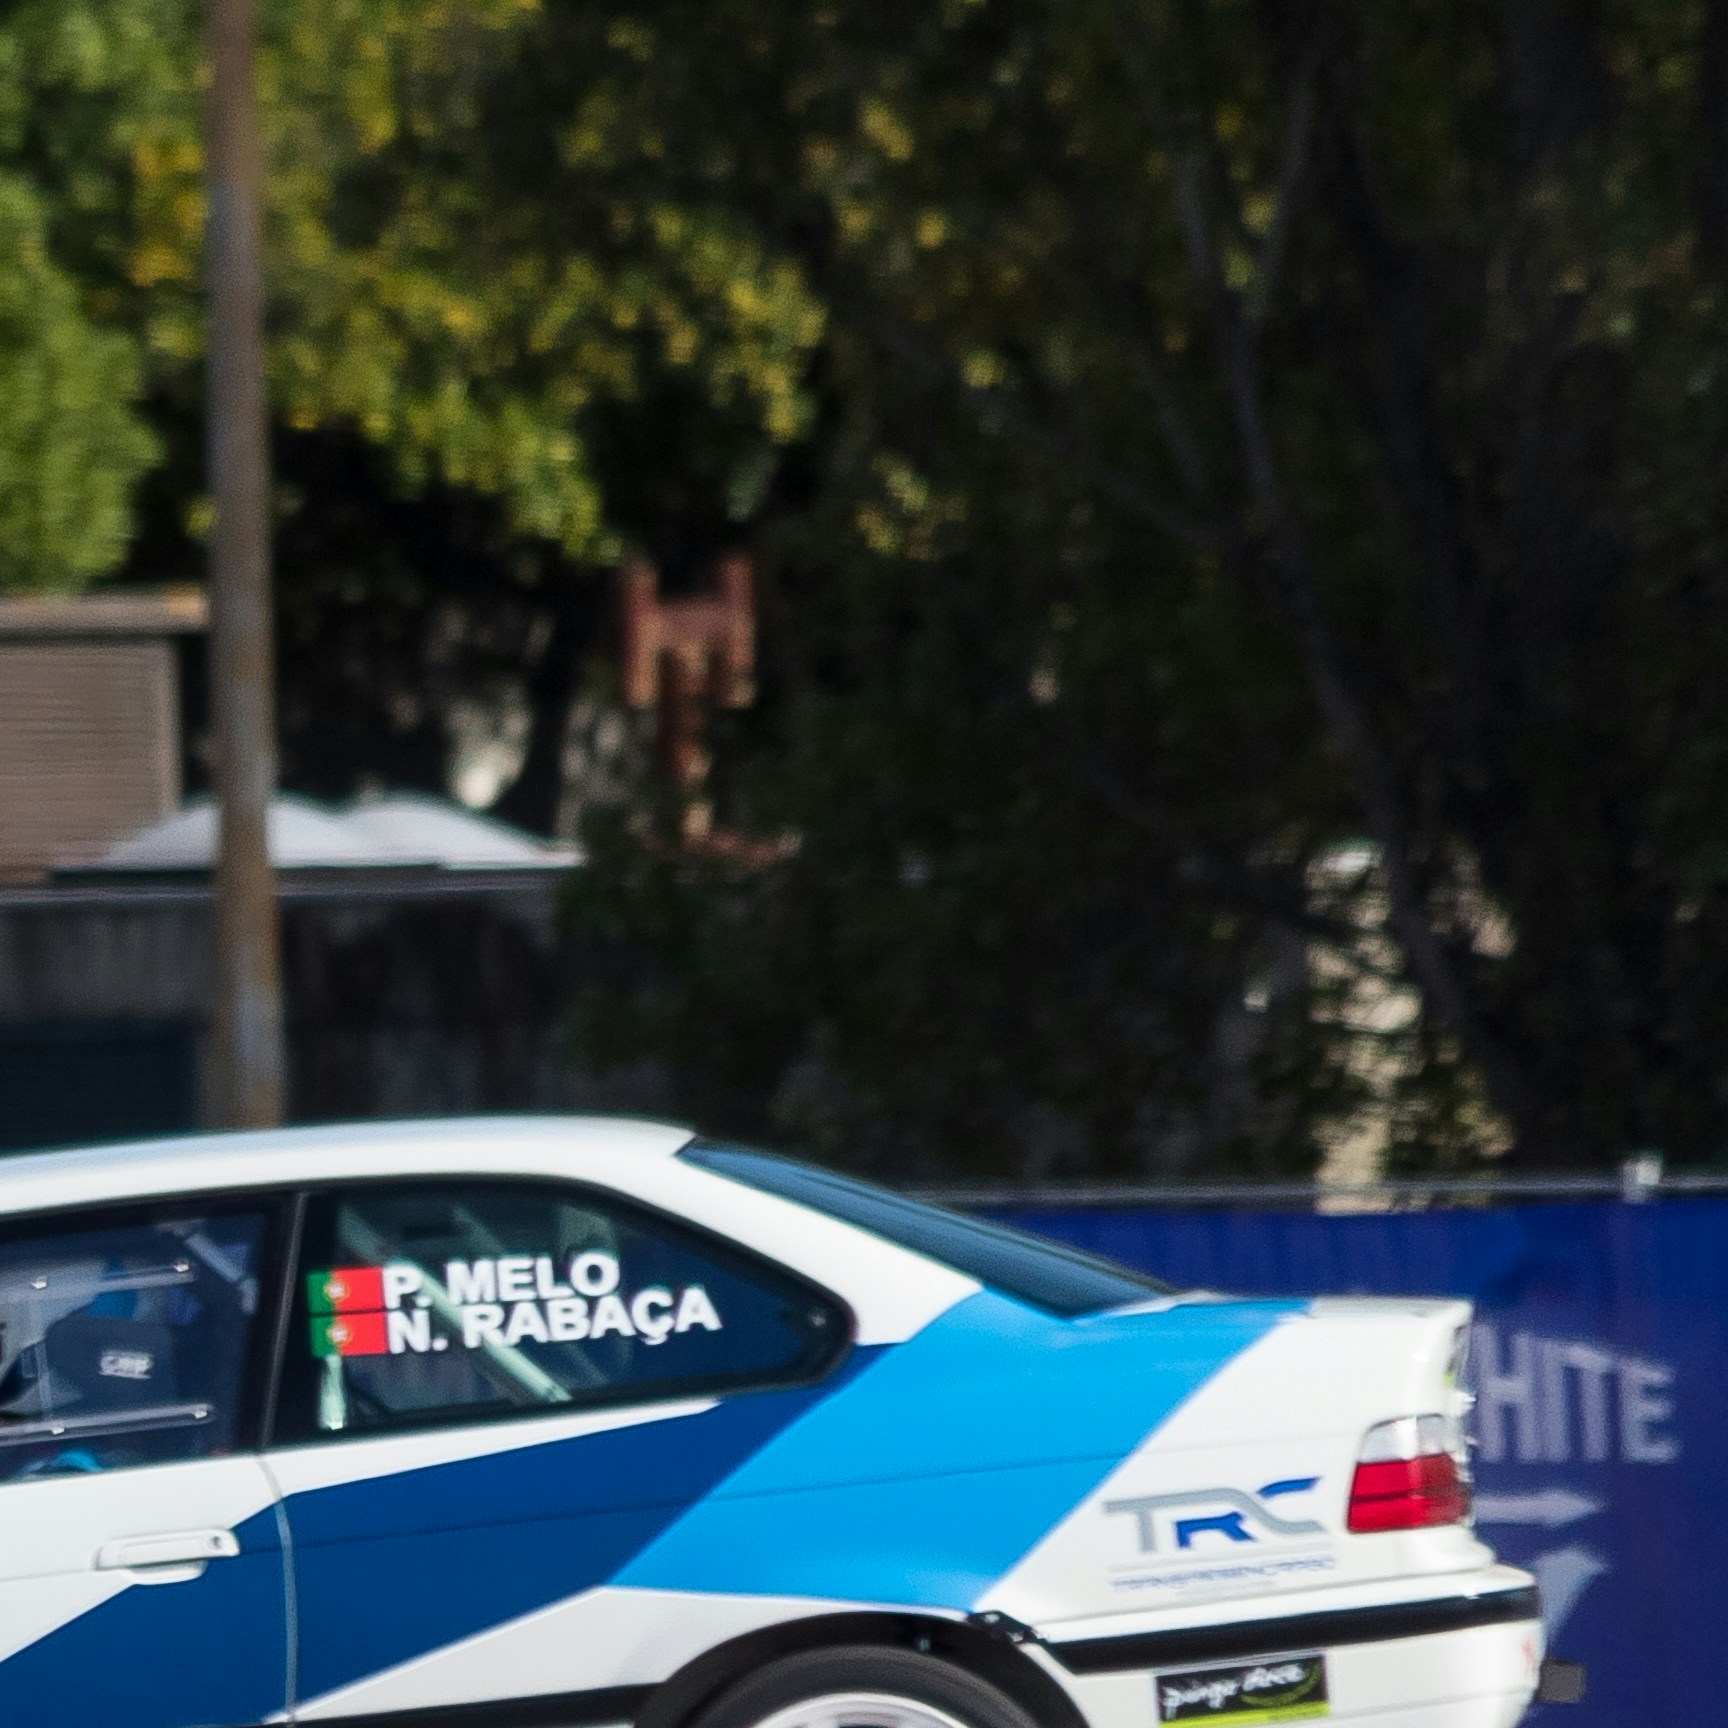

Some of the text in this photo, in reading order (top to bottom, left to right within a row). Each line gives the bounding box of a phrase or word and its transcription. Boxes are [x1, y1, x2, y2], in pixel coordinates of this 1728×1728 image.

[382, 1253, 621, 1310] P. MELO
[386, 1285, 723, 1355] N. RABAÇA
[1103, 1475, 1328, 1554] TRC
